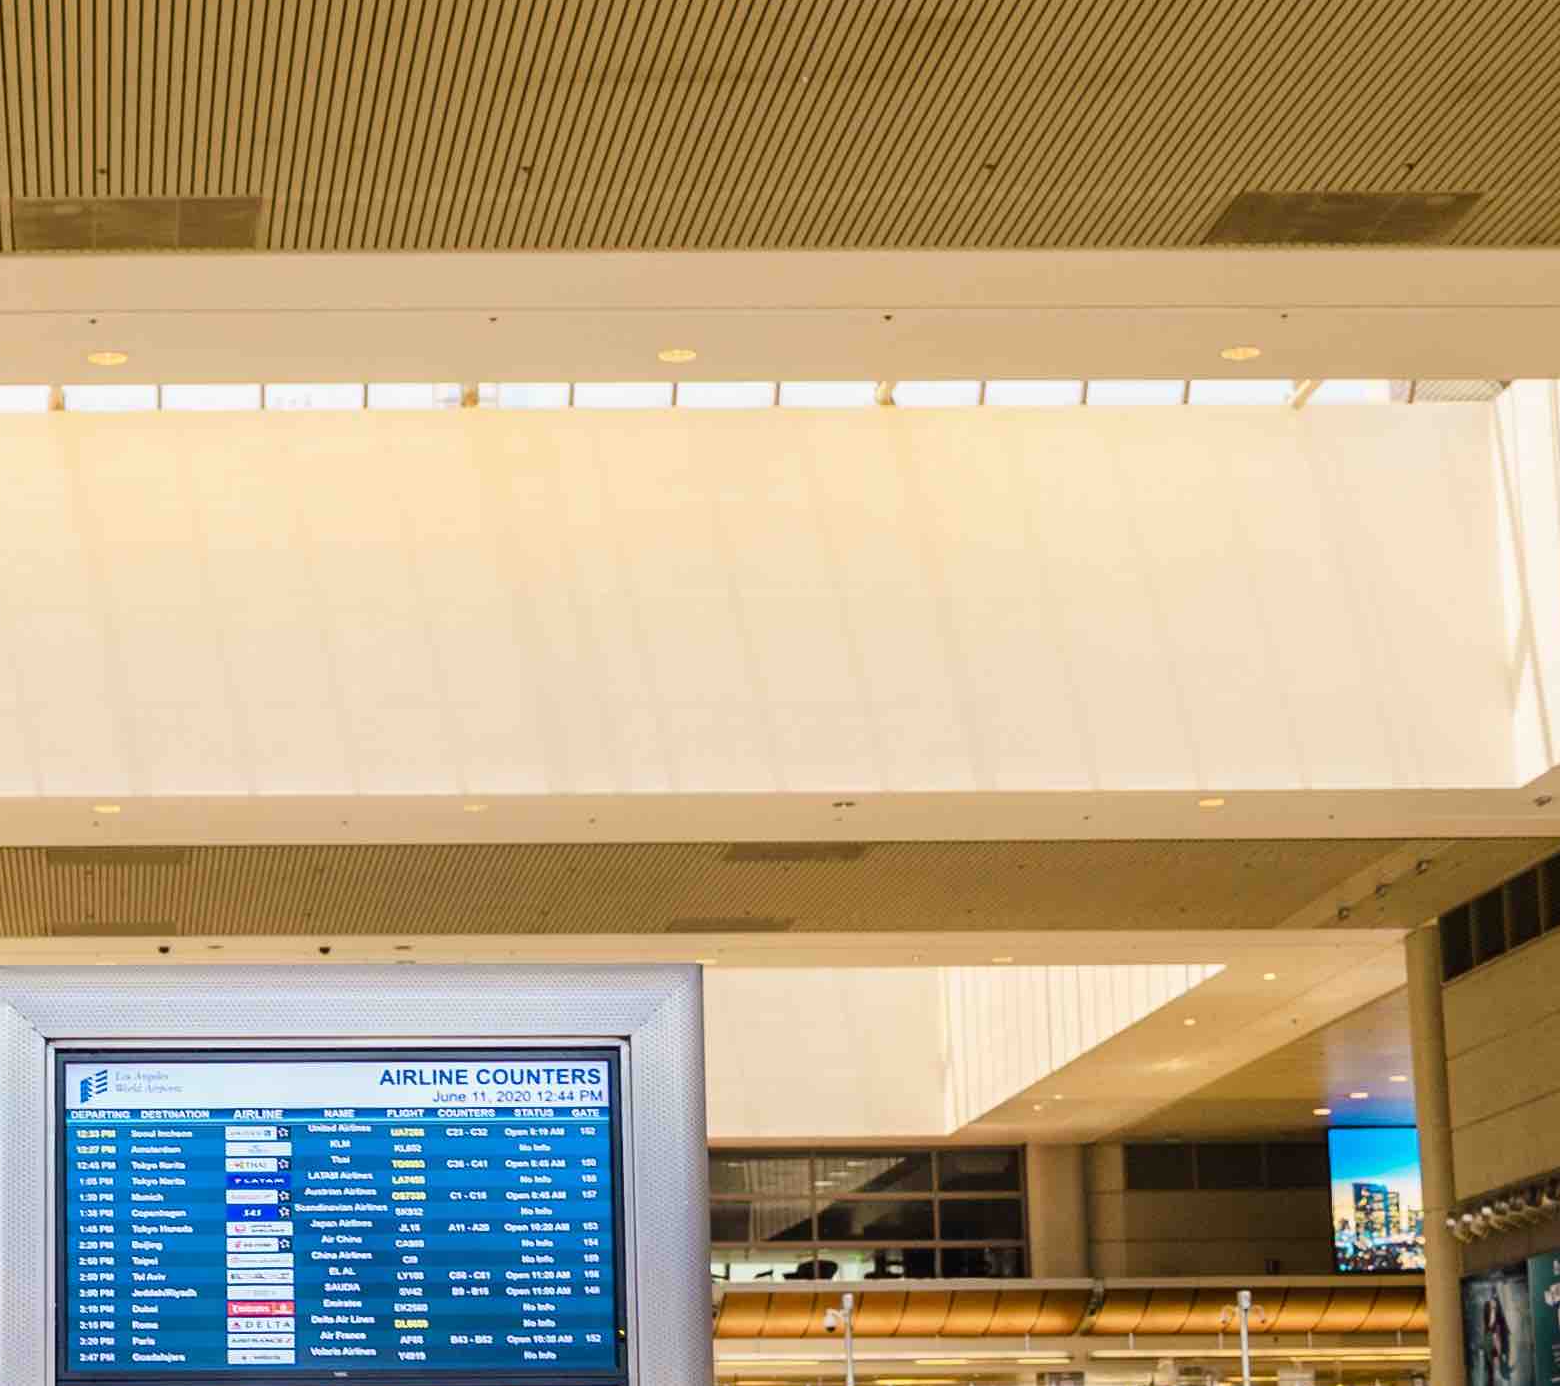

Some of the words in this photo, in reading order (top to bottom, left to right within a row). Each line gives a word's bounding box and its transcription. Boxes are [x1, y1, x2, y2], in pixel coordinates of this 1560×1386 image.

[380, 1069, 468, 1086] AIRLINE
[476, 1068, 601, 1085] COUNTERS
[433, 1091, 466, 1103] June
[497, 1091, 534, 1102] 2020
[538, 1090, 574, 1102] 12:44
[580, 1090, 603, 1101] PM
[71, 1110, 130, 1119] DEPARTING
[141, 1110, 209, 1119] DESTINATION
[233, 1110, 283, 1119] AIRLINE
[324, 1109, 355, 1118] NAME
[387, 1109, 424, 1118] FLIGHT
[437, 1109, 495, 1118] COUNTERS
[514, 1109, 553, 1118] STATUS
[572, 1109, 599, 1118] GATE
